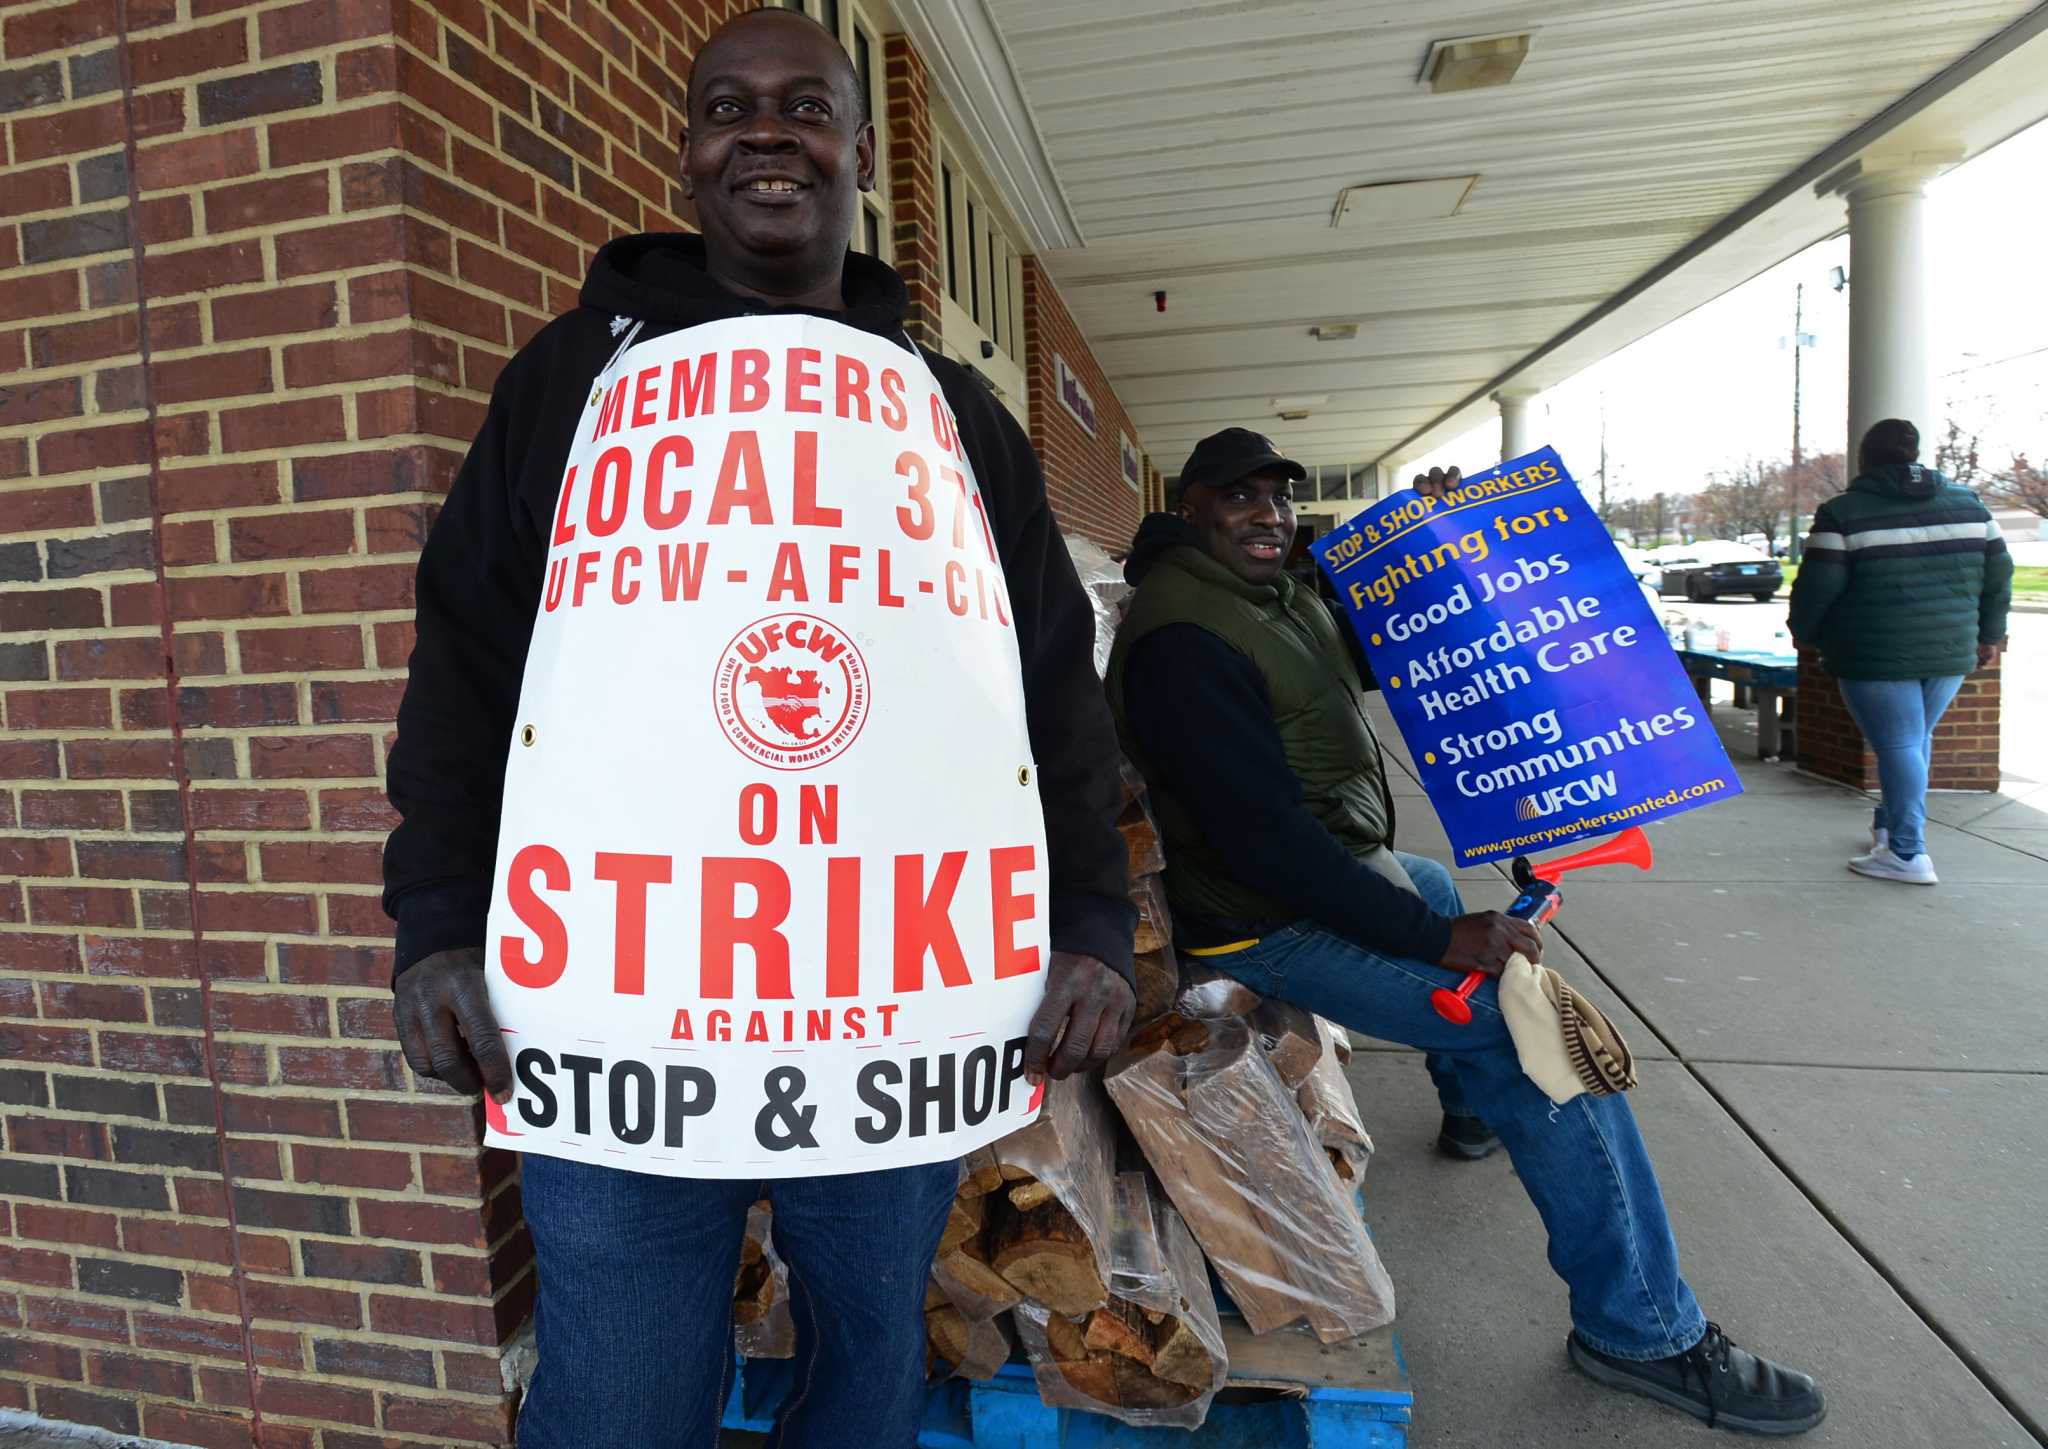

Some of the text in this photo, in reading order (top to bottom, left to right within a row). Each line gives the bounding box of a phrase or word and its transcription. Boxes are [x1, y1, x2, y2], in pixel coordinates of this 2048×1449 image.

[591, 347, 908, 442] MEMBERS
[552, 430, 997, 564] LOCAL 371
[1324, 461, 1557, 567] STOP & SHOP WORKERS
[545, 542, 1010, 627] UFCW-AFL-CIO
[1348, 506, 1569, 610] Fighting for:
[1386, 553, 1570, 641] Good Jobs
[720, 657, 736, 688] UNITED
[735, 620, 847, 664] UFCW
[846, 653, 861, 679] UNION
[1408, 596, 1601, 688] Affordable
[1418, 624, 1638, 721] Health Care
[732, 726, 784, 763] COMMERCIAL
[788, 745, 832, 763] WORKERS
[832, 684, 863, 752] INTERNATIONAL
[1440, 708, 1562, 765] Strong
[1456, 705, 1696, 798] Communities
[738, 782, 839, 846] ON
[1464, 779, 1725, 858] www.groceryworkersunited.com
[1529, 771, 1617, 818] UFCW
[500, 843, 1041, 1000] STRIKE
[671, 1003, 900, 1043] AGAINST
[516, 1035, 1028, 1152] STOP & SHOP
